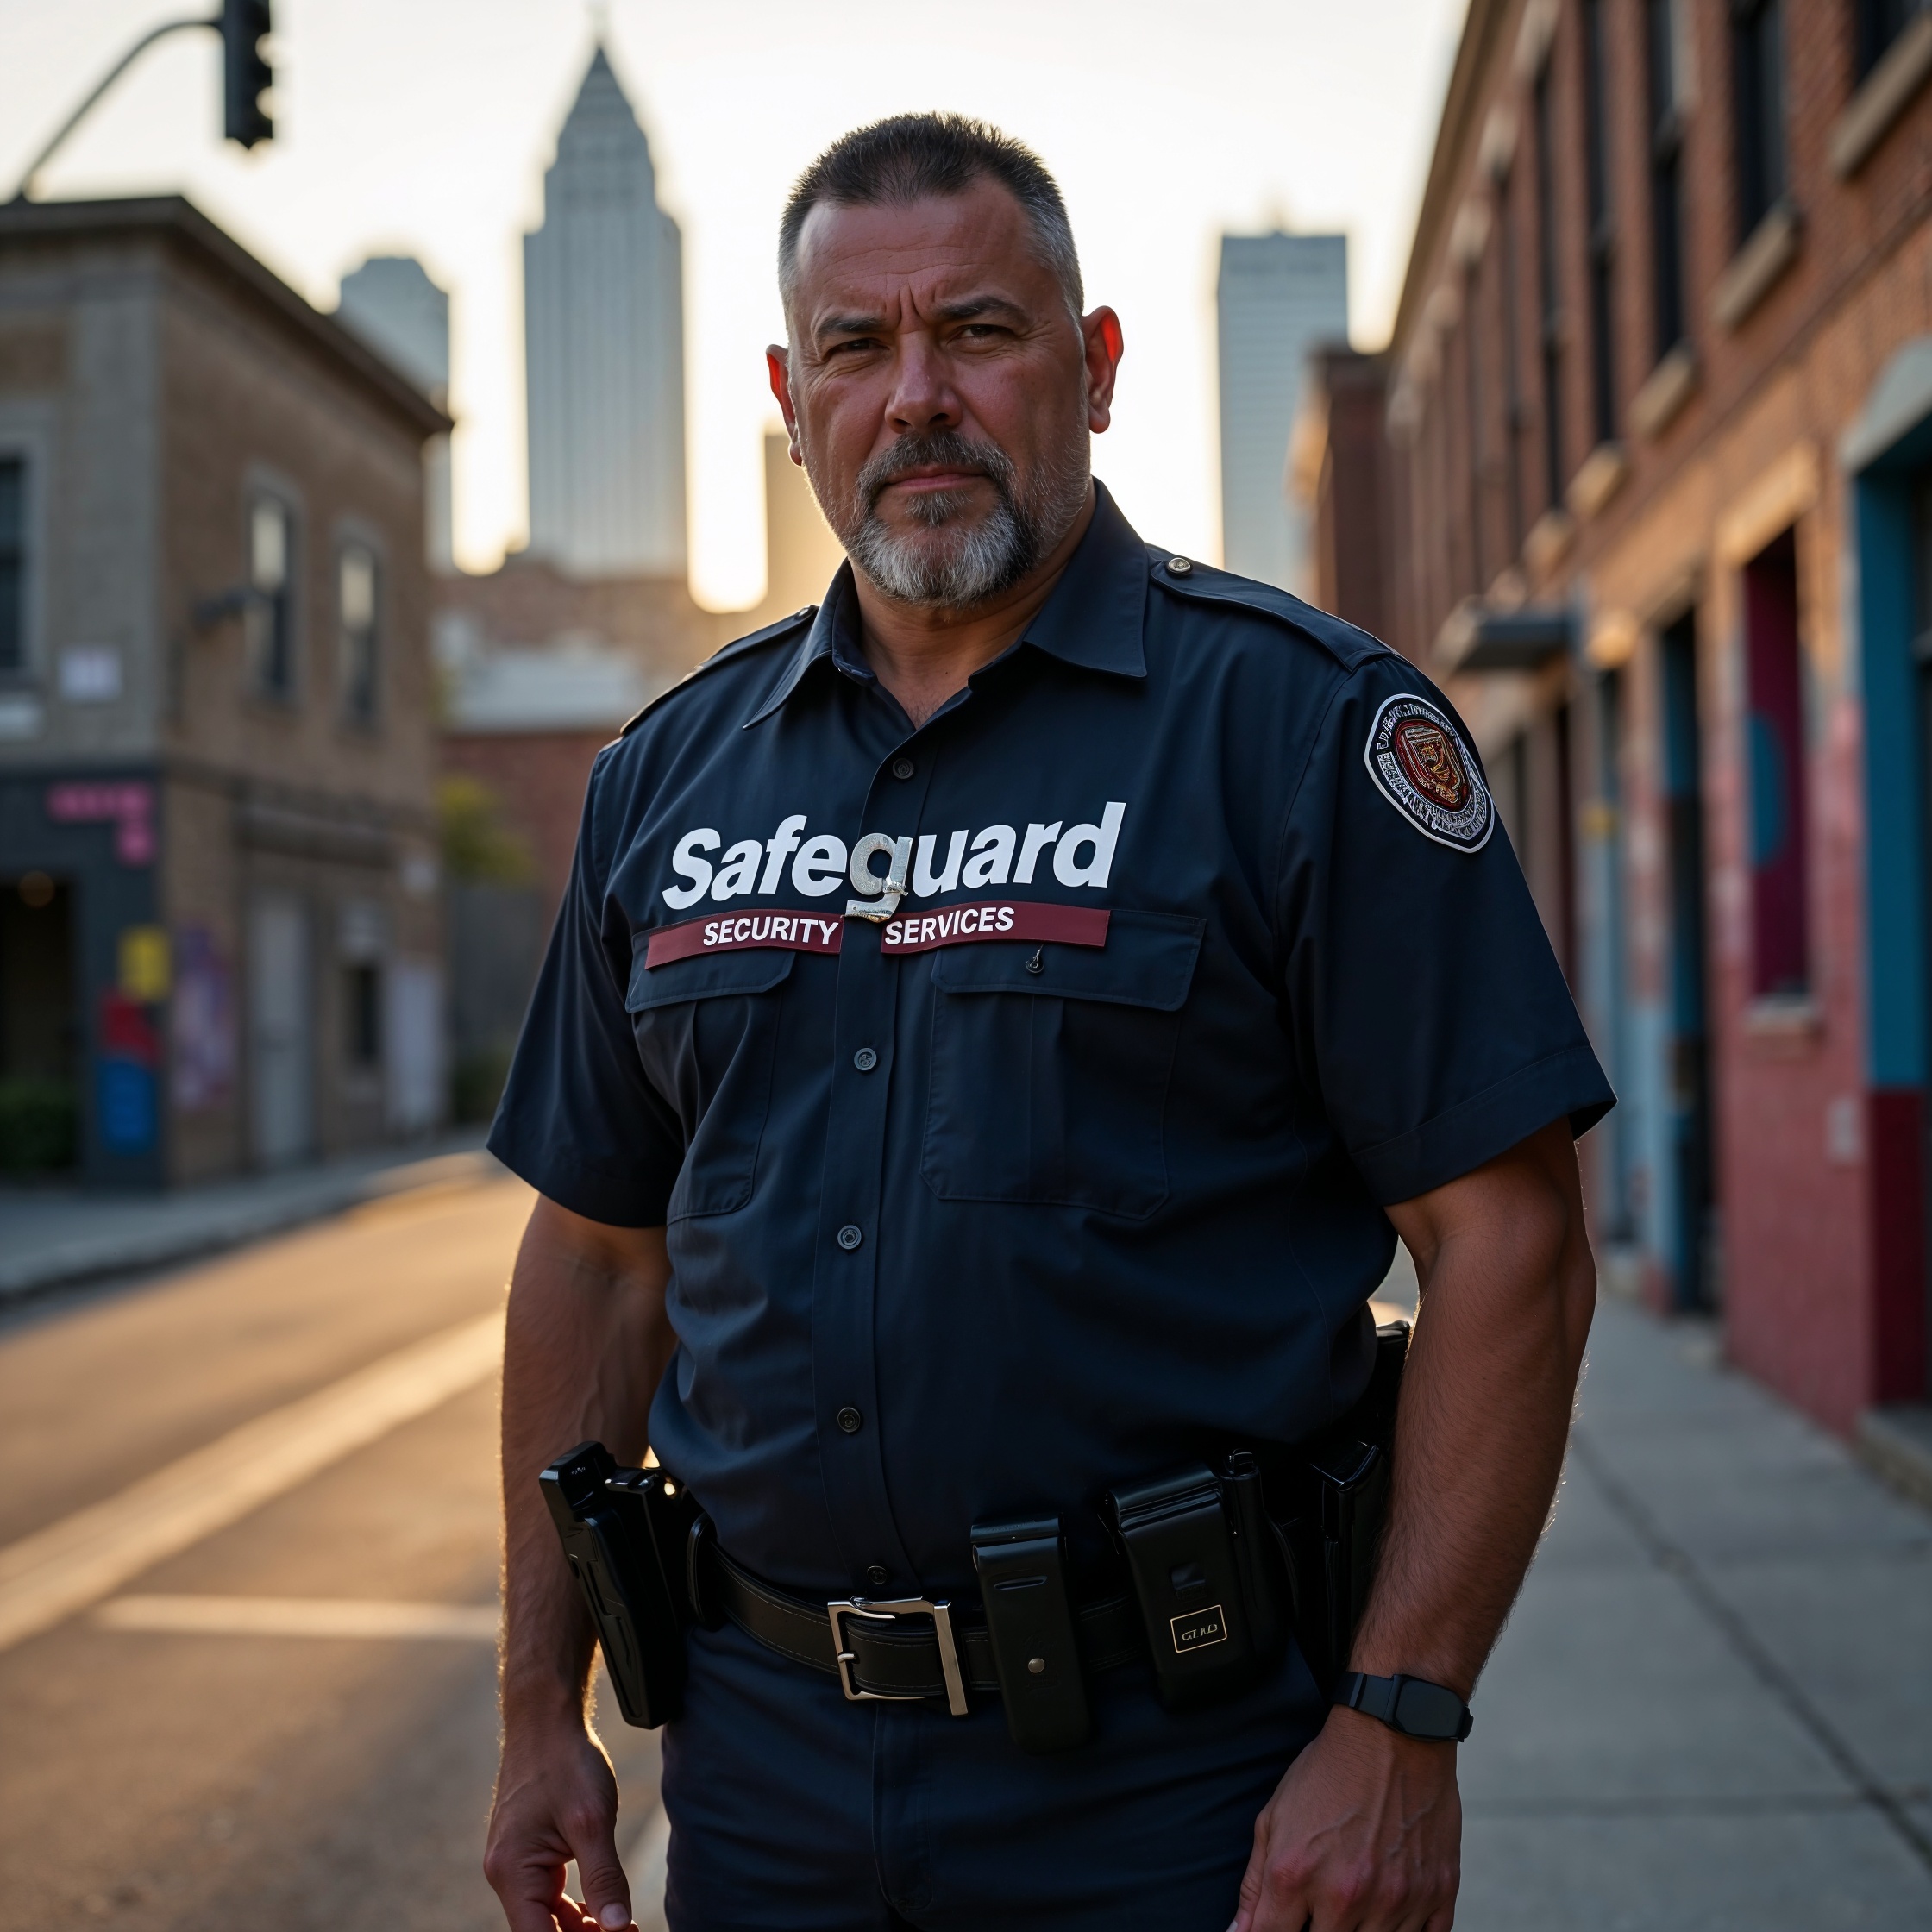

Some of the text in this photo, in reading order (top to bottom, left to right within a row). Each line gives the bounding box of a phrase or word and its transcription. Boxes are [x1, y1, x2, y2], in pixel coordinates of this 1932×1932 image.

[662, 801, 1126, 922] Safeguard
[703, 907, 1014, 946] SECURITY SERVICES
